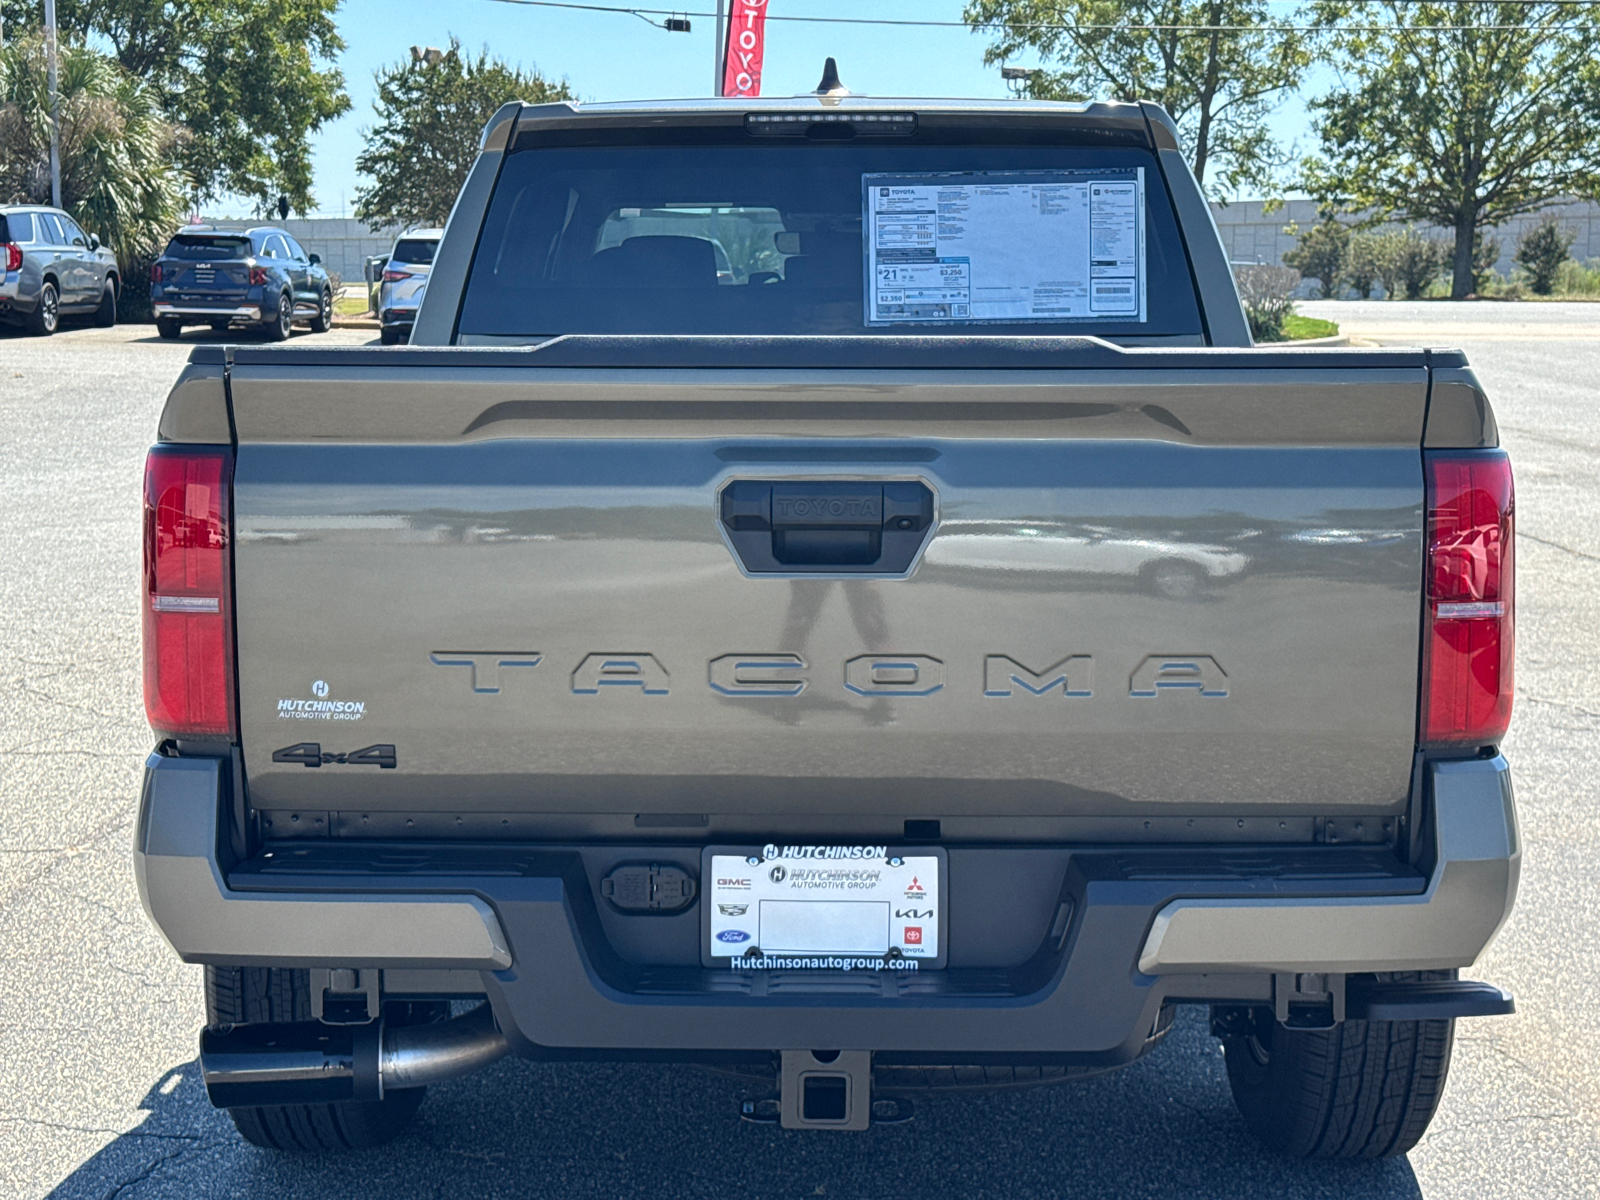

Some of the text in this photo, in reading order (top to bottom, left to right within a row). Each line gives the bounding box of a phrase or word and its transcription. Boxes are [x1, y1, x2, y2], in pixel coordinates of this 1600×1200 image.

[736, 9, 758, 97] TOYO
[883, 269, 897, 280] 21
[880, 295, 903, 303] $2,350
[777, 499, 877, 517] TOYOTA
[430, 650, 1230, 696] TACOMA
[277, 699, 365, 713] HUTCHINSON
[279, 711, 361, 720] AUTOMOTIVE GROUP
[781, 845, 887, 860] HUTCHINSON
[789, 868, 880, 882] HUTCHINSON
[791, 881, 876, 889] AUTOMOTIVE GROUP
[722, 931, 745, 942] Ford
[731, 955, 919, 971] Hutchinsonautogroup.com
